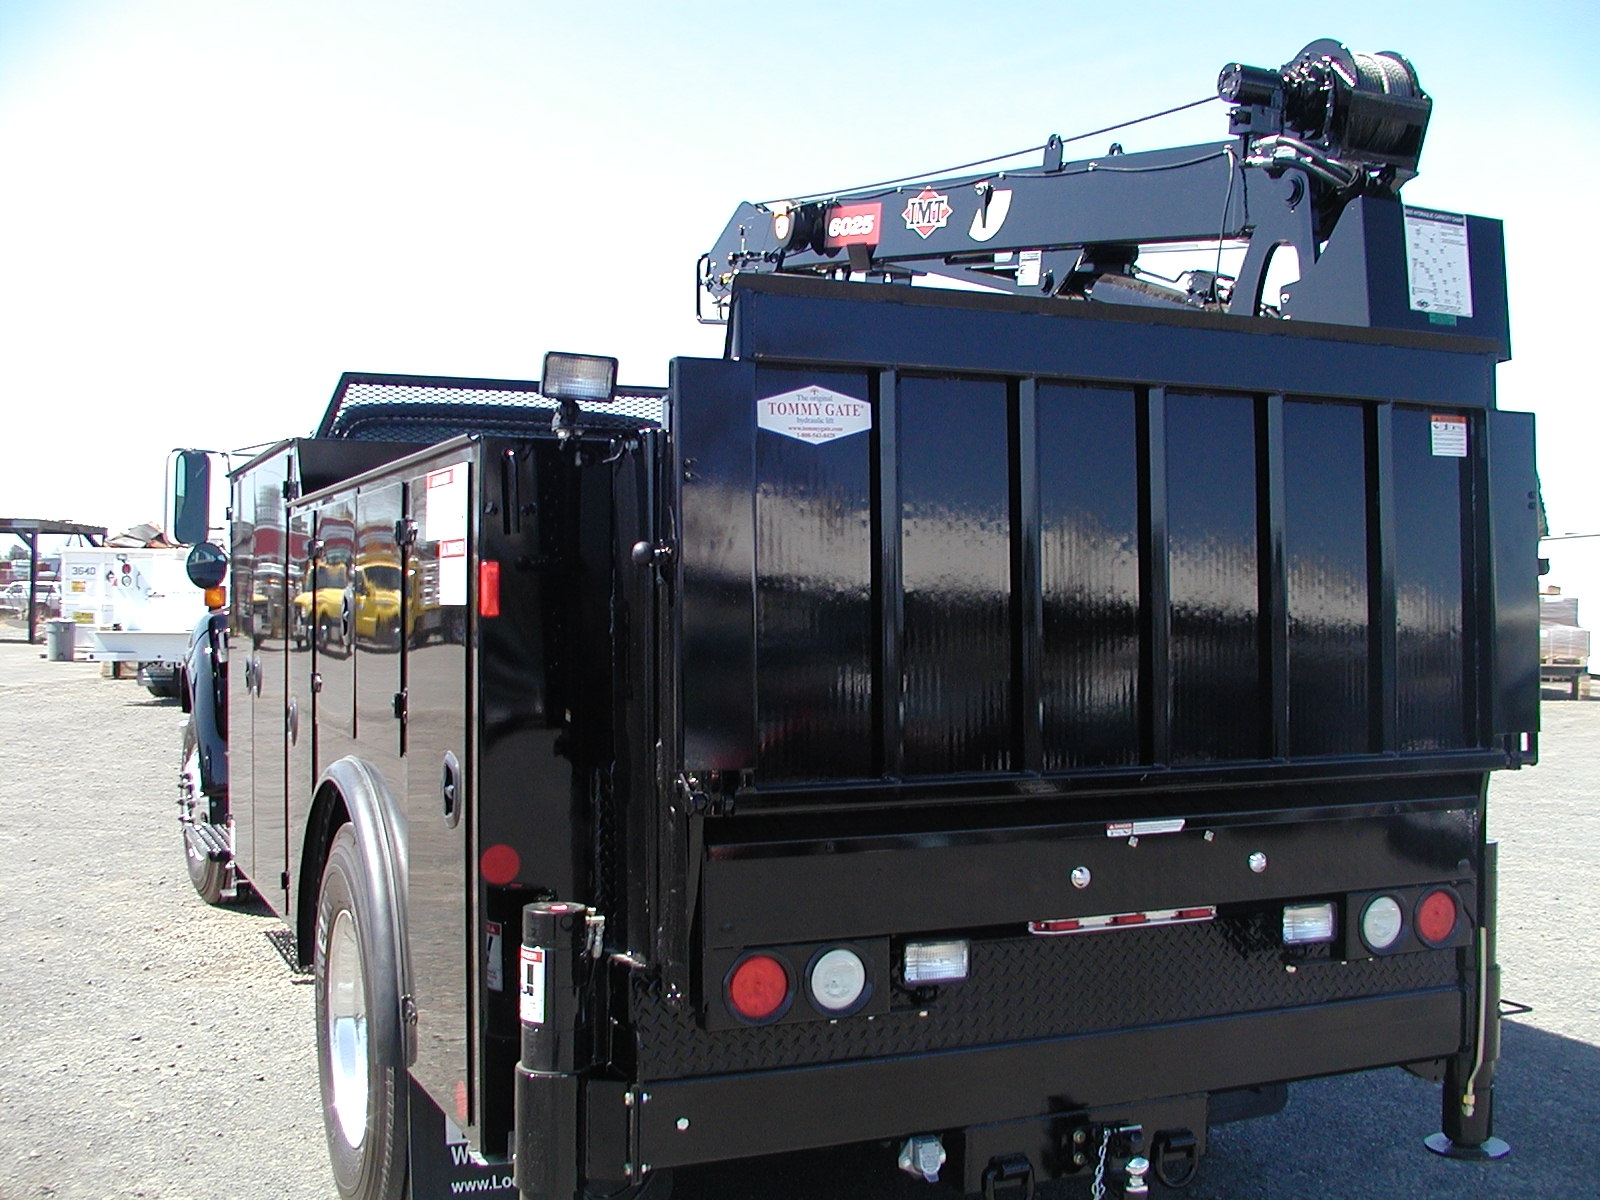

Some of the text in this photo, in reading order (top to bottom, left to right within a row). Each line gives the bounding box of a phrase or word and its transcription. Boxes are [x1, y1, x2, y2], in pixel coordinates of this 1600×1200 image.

[909, 199, 945, 226] IMT
[828, 214, 875, 237] 6025
[797, 394, 833, 403] The original
[768, 402, 822, 416] TOMMY
[797, 417, 824, 425] hydraulic
[788, 425, 844, 433] www.tommygate.com
